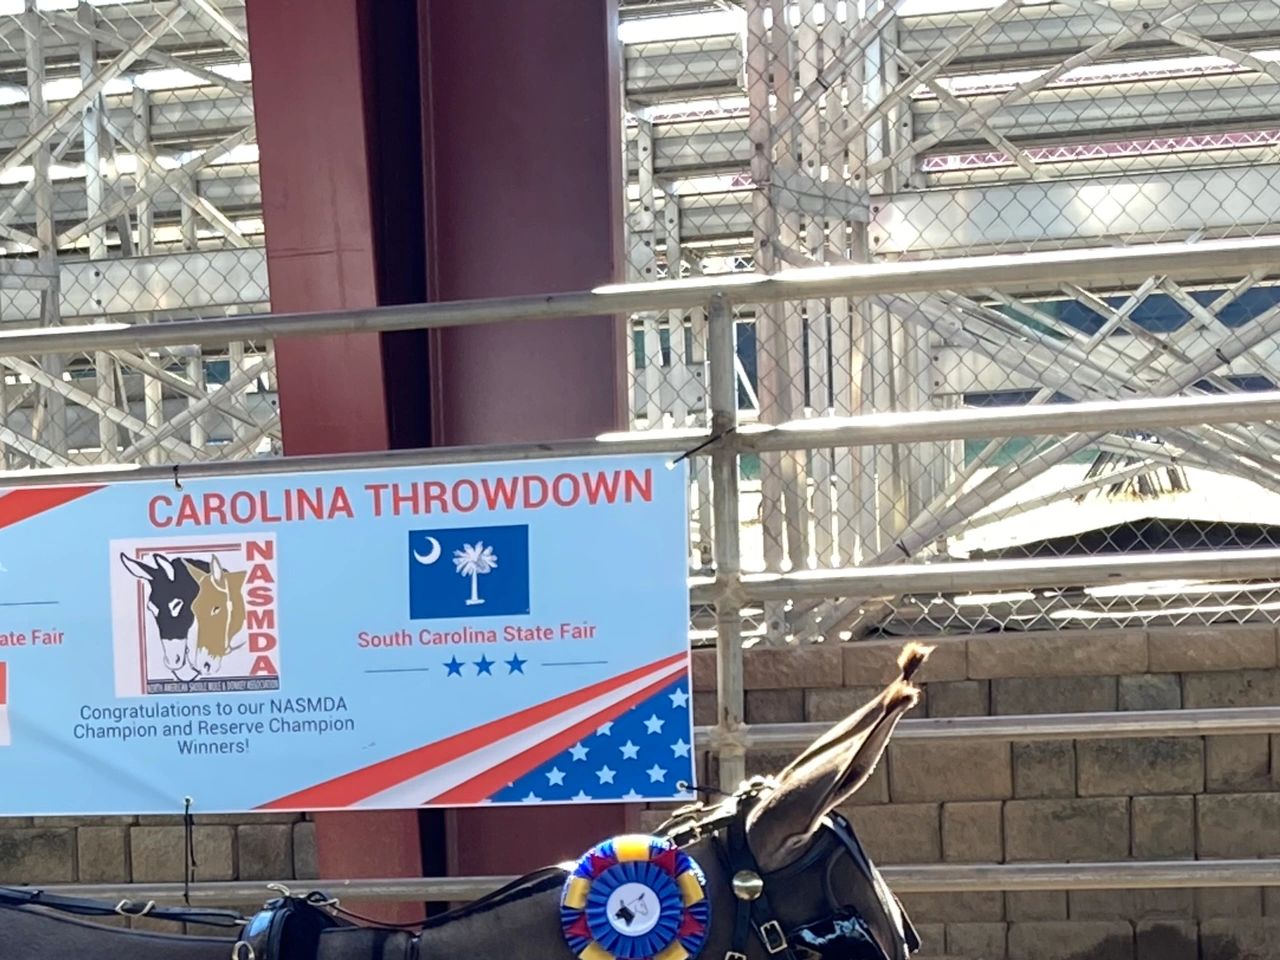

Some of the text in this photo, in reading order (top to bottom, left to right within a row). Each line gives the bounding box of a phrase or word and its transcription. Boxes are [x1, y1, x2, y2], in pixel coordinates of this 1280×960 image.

[148, 468, 654, 528] CAROLINA THROWDOWN
[246, 540, 279, 676] NASMDA
[31, 628, 65, 645] Fair
[358, 621, 597, 648] South Carolina State Fair
[80, 697, 348, 722] Congratulations to our NASMDA
[74, 717, 355, 741] Champion and Reserve Champion
[177, 738, 250, 754] Winners!
